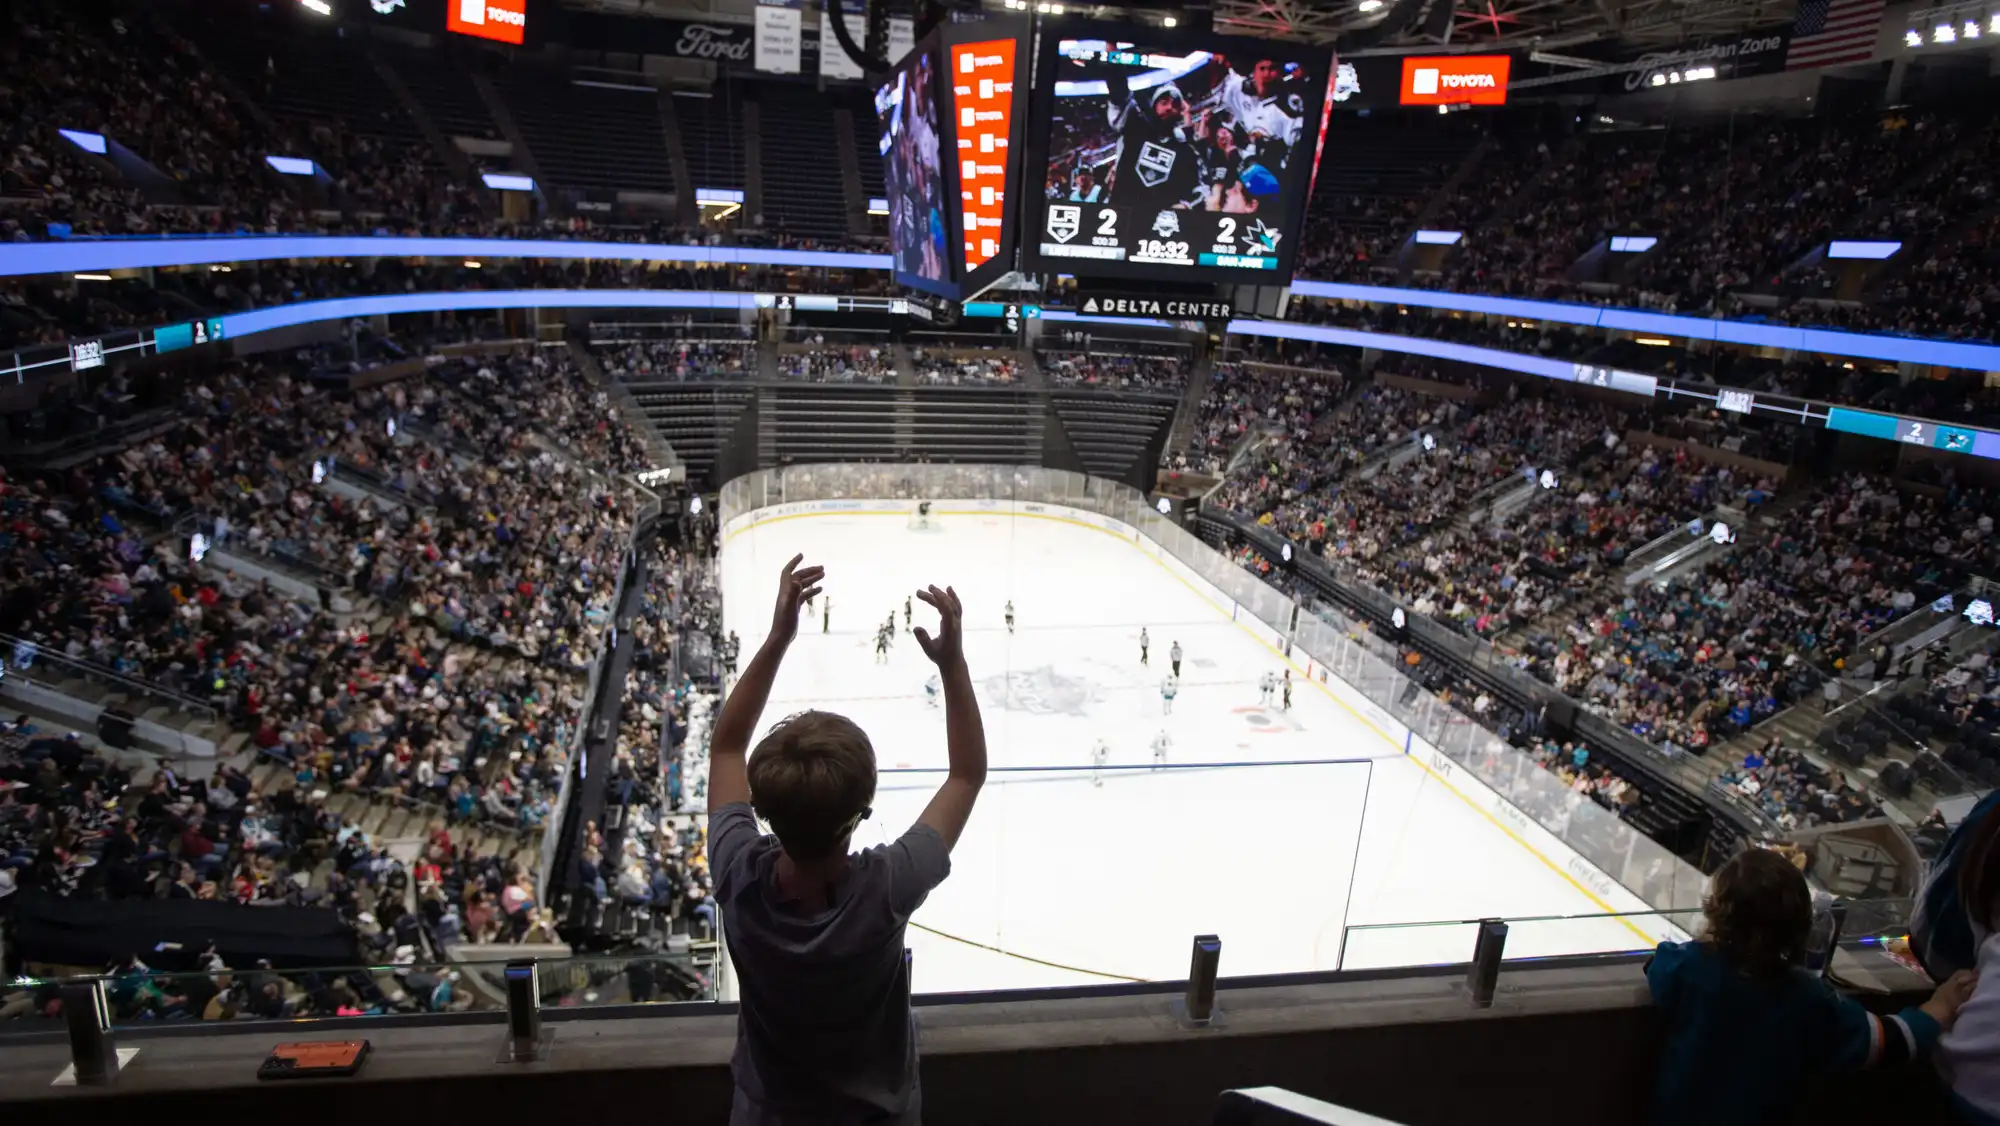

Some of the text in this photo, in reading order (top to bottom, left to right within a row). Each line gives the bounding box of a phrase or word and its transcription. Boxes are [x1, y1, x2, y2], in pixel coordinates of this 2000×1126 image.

[675, 24, 752, 61] Ford
[1738, 36, 1782, 55] Zone
[1441, 73, 1496, 89] TOYOTA
[1097, 208, 1118, 236] 2
[1216, 217, 1238, 244] 2
[1102, 298, 1230, 318] DELTA CENTER
[1909, 422, 1922, 437] 2
